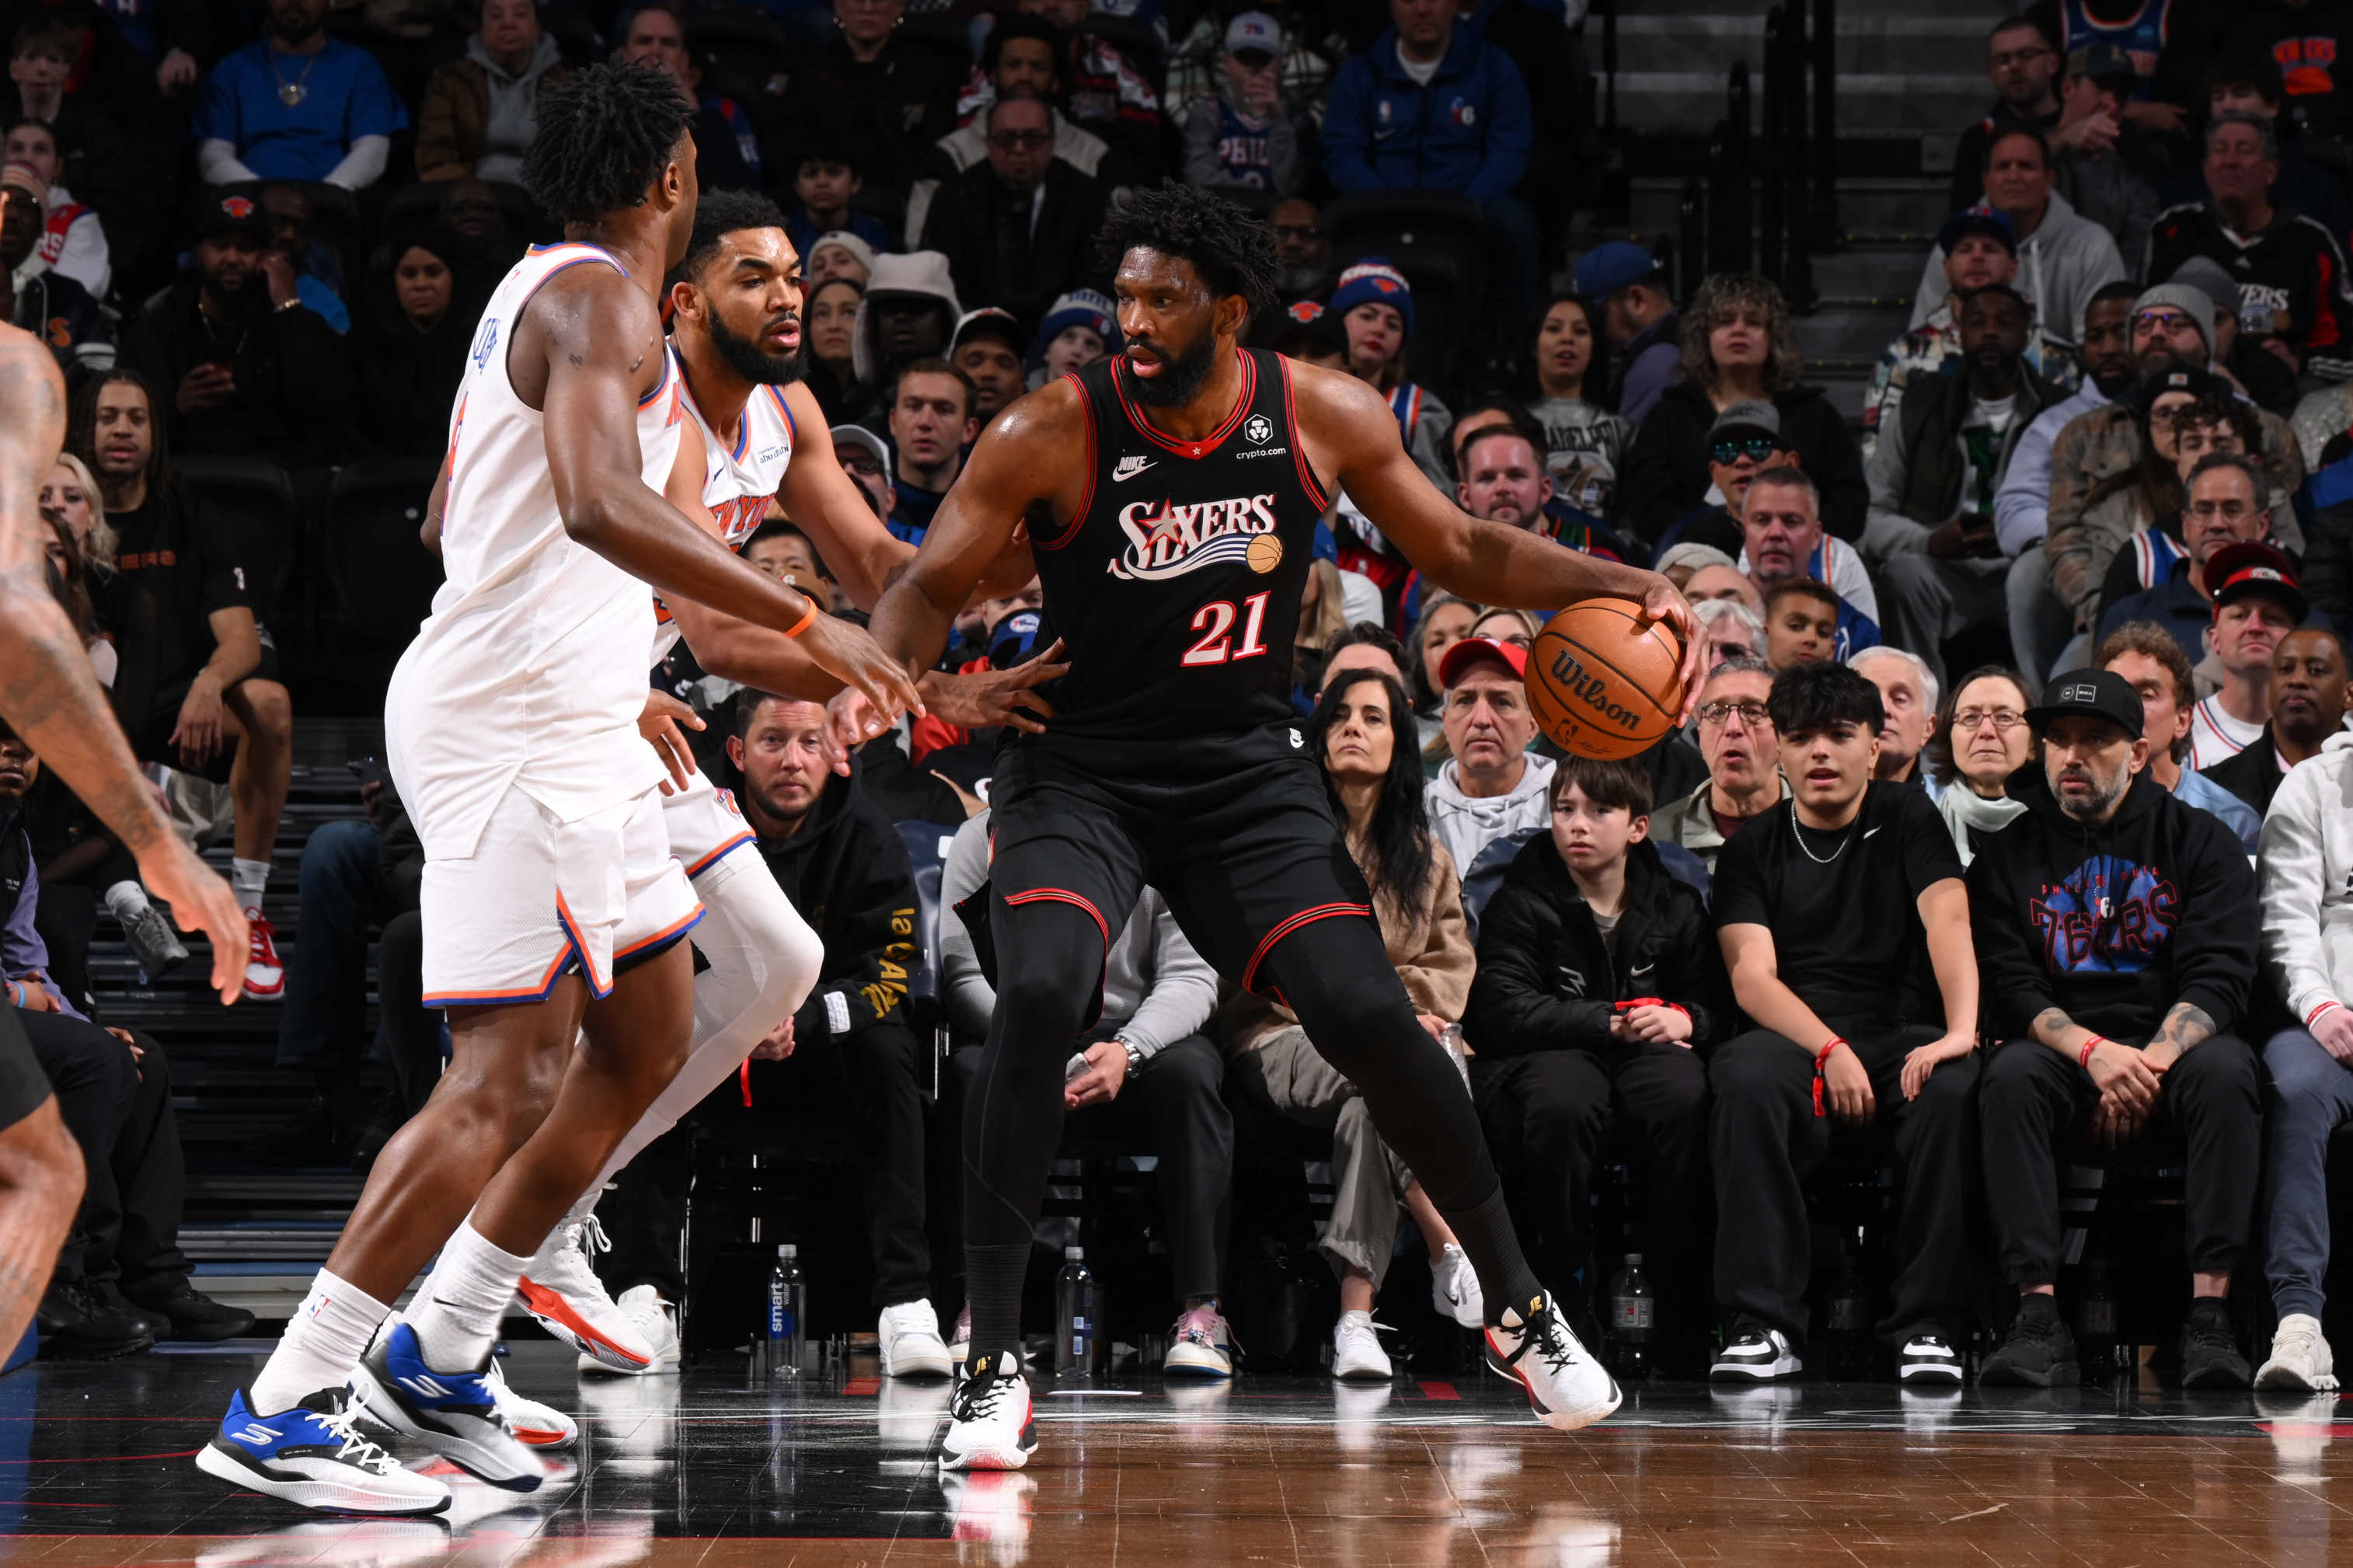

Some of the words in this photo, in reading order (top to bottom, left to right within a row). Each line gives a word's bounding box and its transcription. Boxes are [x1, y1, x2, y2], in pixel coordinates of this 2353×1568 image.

[1117, 455, 1148, 471] NIKE
[1236, 447, 1286, 460] crypto.com
[1180, 591, 1271, 667] 21
[1551, 648, 1641, 730] Wilson
[770, 1282, 783, 1332] smart
